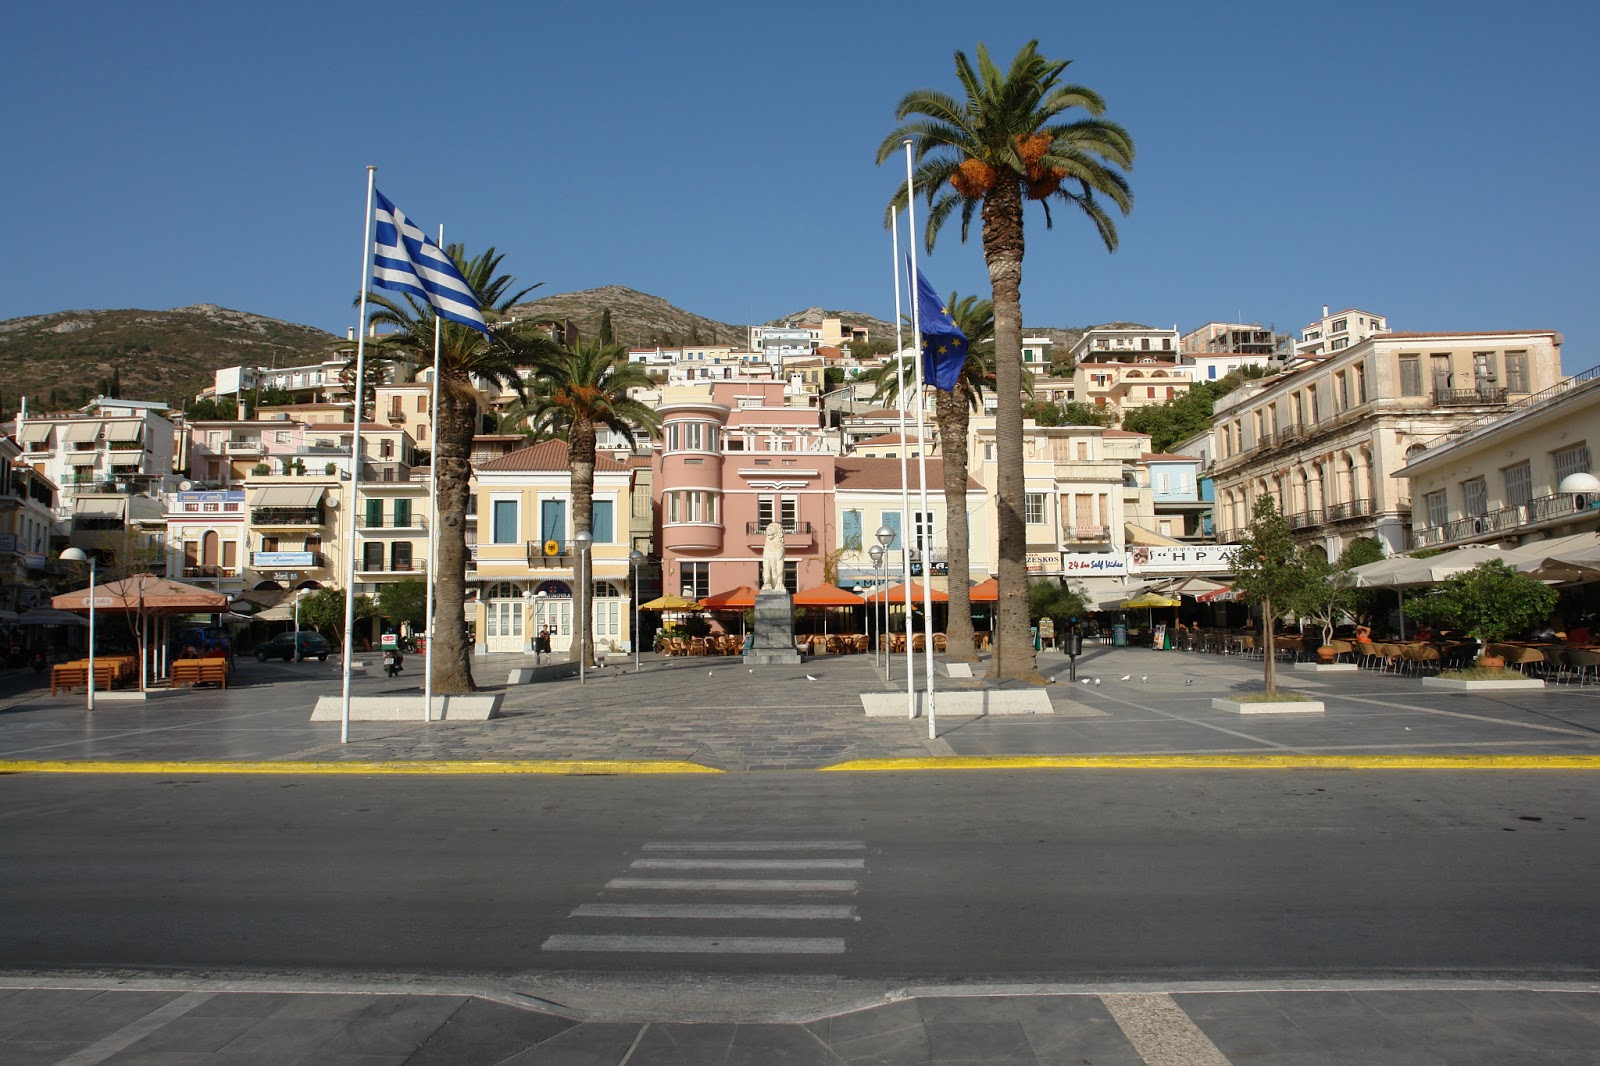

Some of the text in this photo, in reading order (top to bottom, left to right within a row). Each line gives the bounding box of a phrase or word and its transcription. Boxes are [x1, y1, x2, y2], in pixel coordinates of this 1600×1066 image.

[1068, 561, 1079, 570] 24
[1090, 560, 1104, 570] Self
[1105, 560, 1124, 569] Video
